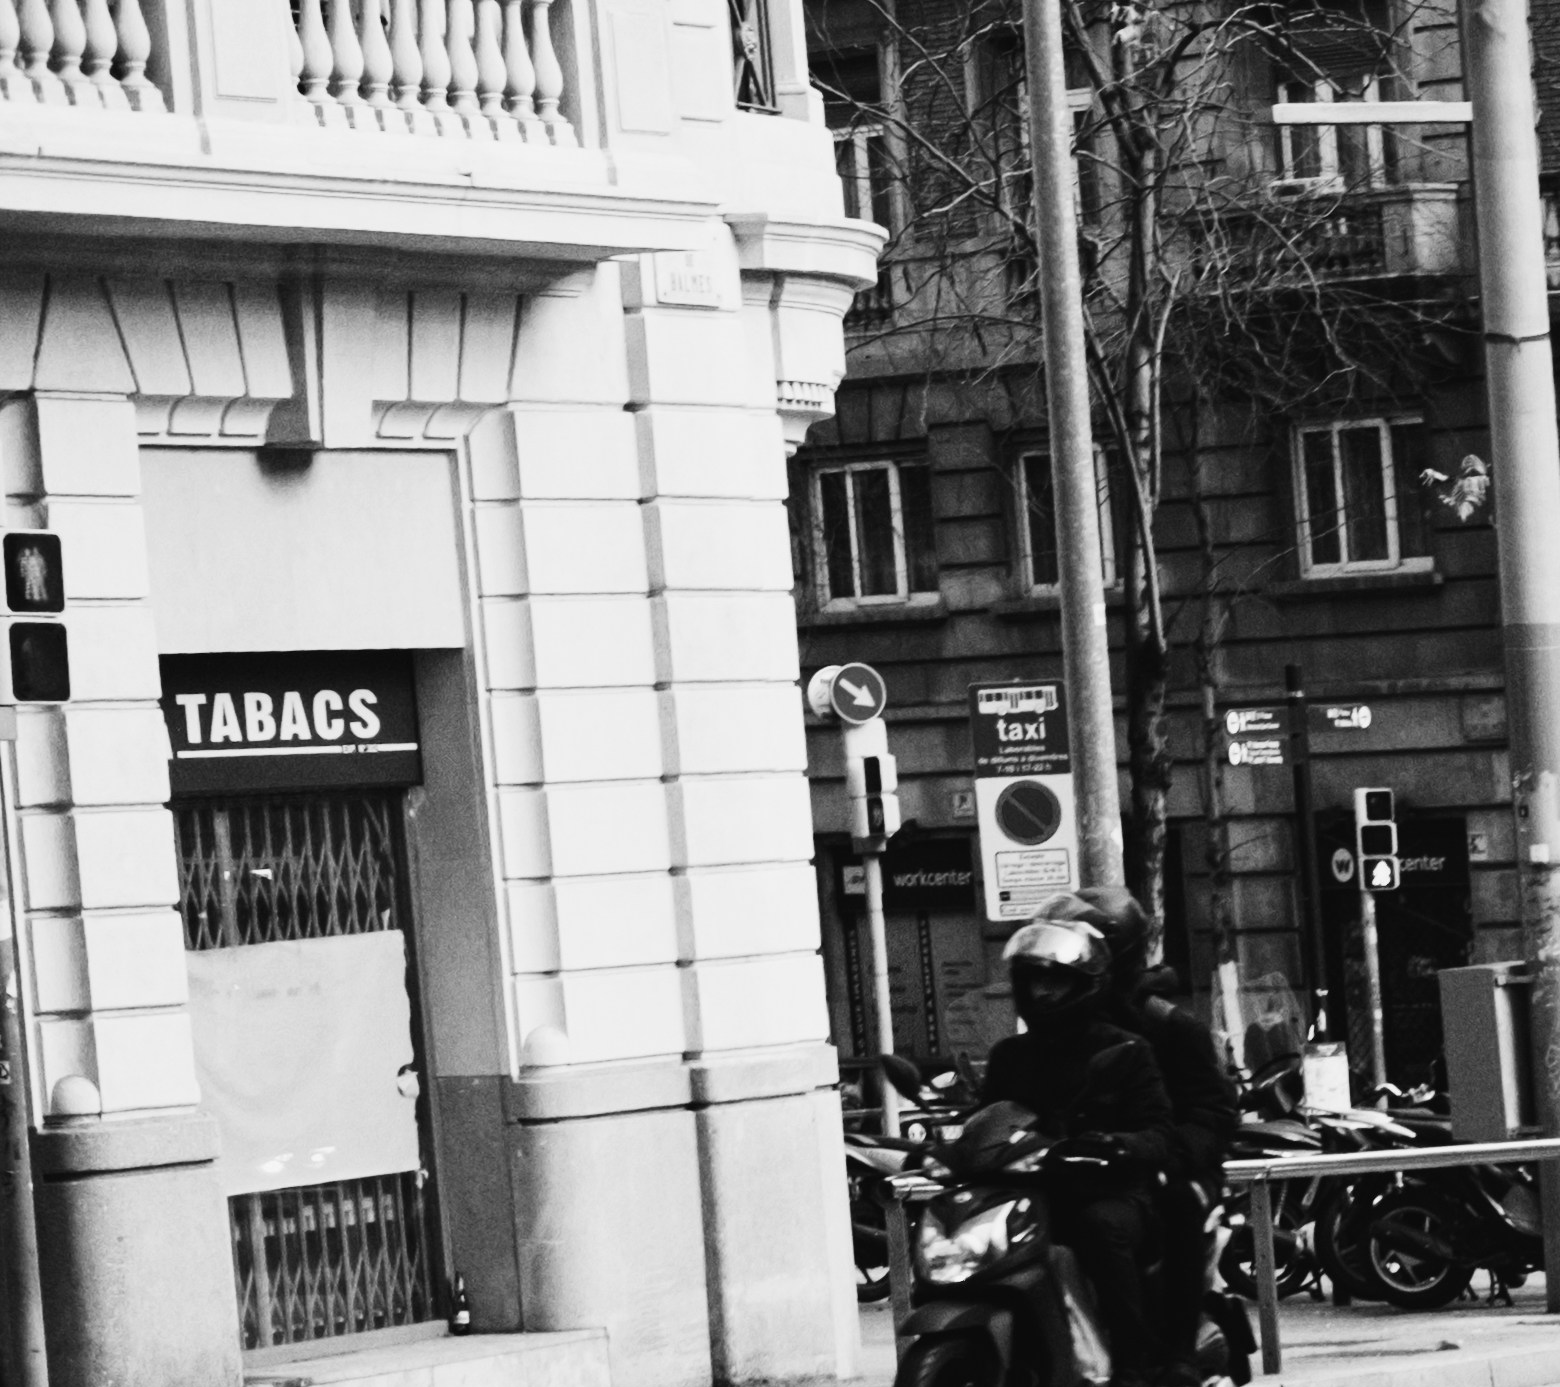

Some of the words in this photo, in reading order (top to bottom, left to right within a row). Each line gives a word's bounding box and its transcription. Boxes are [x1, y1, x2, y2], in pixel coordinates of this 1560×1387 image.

[174, 688, 381, 744] TABACS
[996, 716, 1047, 742] taxi
[892, 868, 973, 888] workcenter
